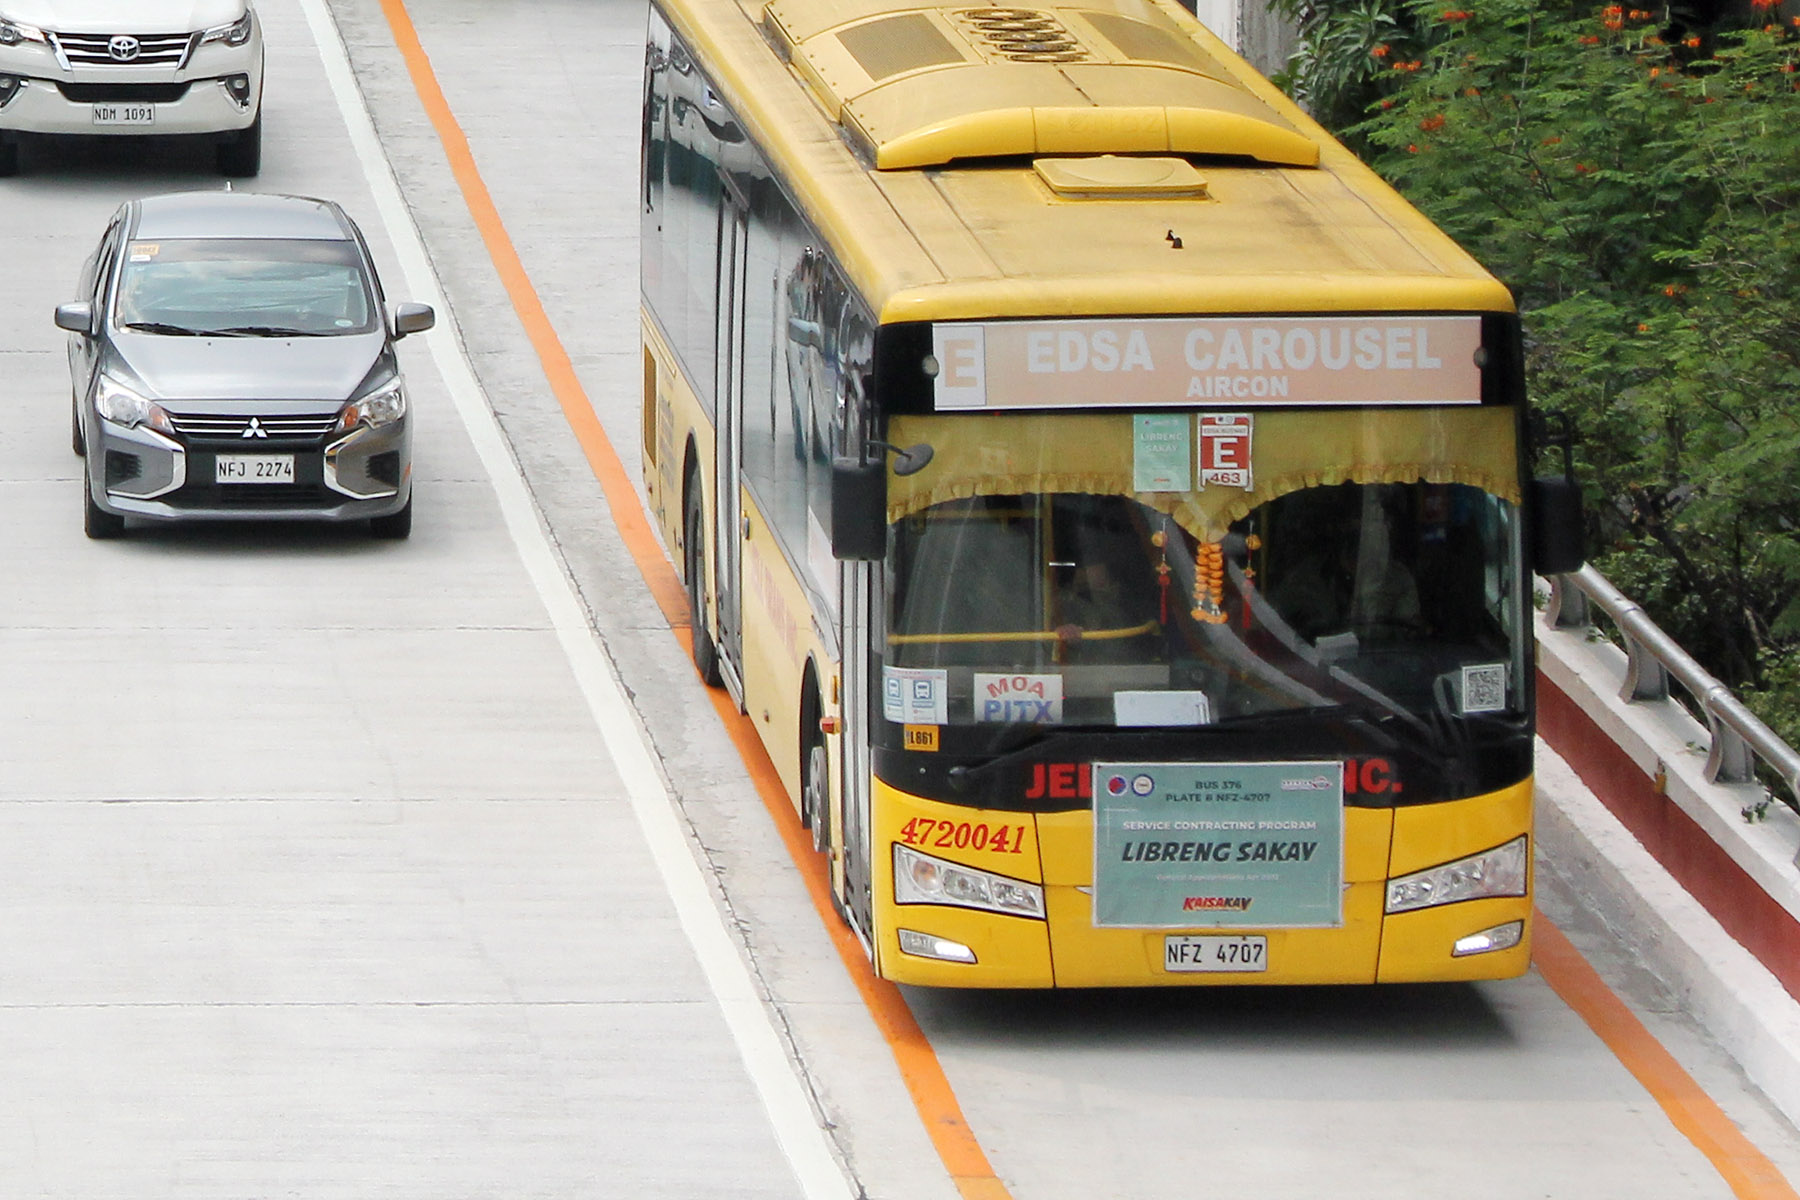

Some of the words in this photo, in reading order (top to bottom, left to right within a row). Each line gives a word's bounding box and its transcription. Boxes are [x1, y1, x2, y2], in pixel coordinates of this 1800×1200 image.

[95, 108, 116, 120] NDM
[124, 108, 152, 120] 1091
[1028, 329, 1154, 373] EDSA
[1183, 327, 1442, 371] CAROUSEL
[944, 338, 978, 388] E
[1187, 376, 1288, 398] AIRCON
[1213, 437, 1238, 468] E
[219, 462, 245, 477] NFJ
[256, 462, 291, 477] 2274
[1210, 472, 1241, 484] 463
[986, 676, 1046, 699] MOA
[984, 700, 1053, 722] PITX
[1195, 781, 1218, 789] BUS
[1221, 781, 1241, 789] 376
[1165, 793, 1201, 802] PLATE
[1216, 793, 1271, 802] NFZ-4707
[901, 817, 1025, 854] 4720041
[1123, 821, 1171, 830] SERVICE
[1174, 821, 1255, 830] CONTRACTING
[1258, 821, 1317, 830] PROGRAM
[1122, 842, 1231, 863] LIBRENG
[1235, 841, 1318, 862] SAKAY
[1183, 897, 1253, 911] KAISAKAY
[1167, 944, 1203, 963] NFZ
[1216, 944, 1264, 963] 4707
